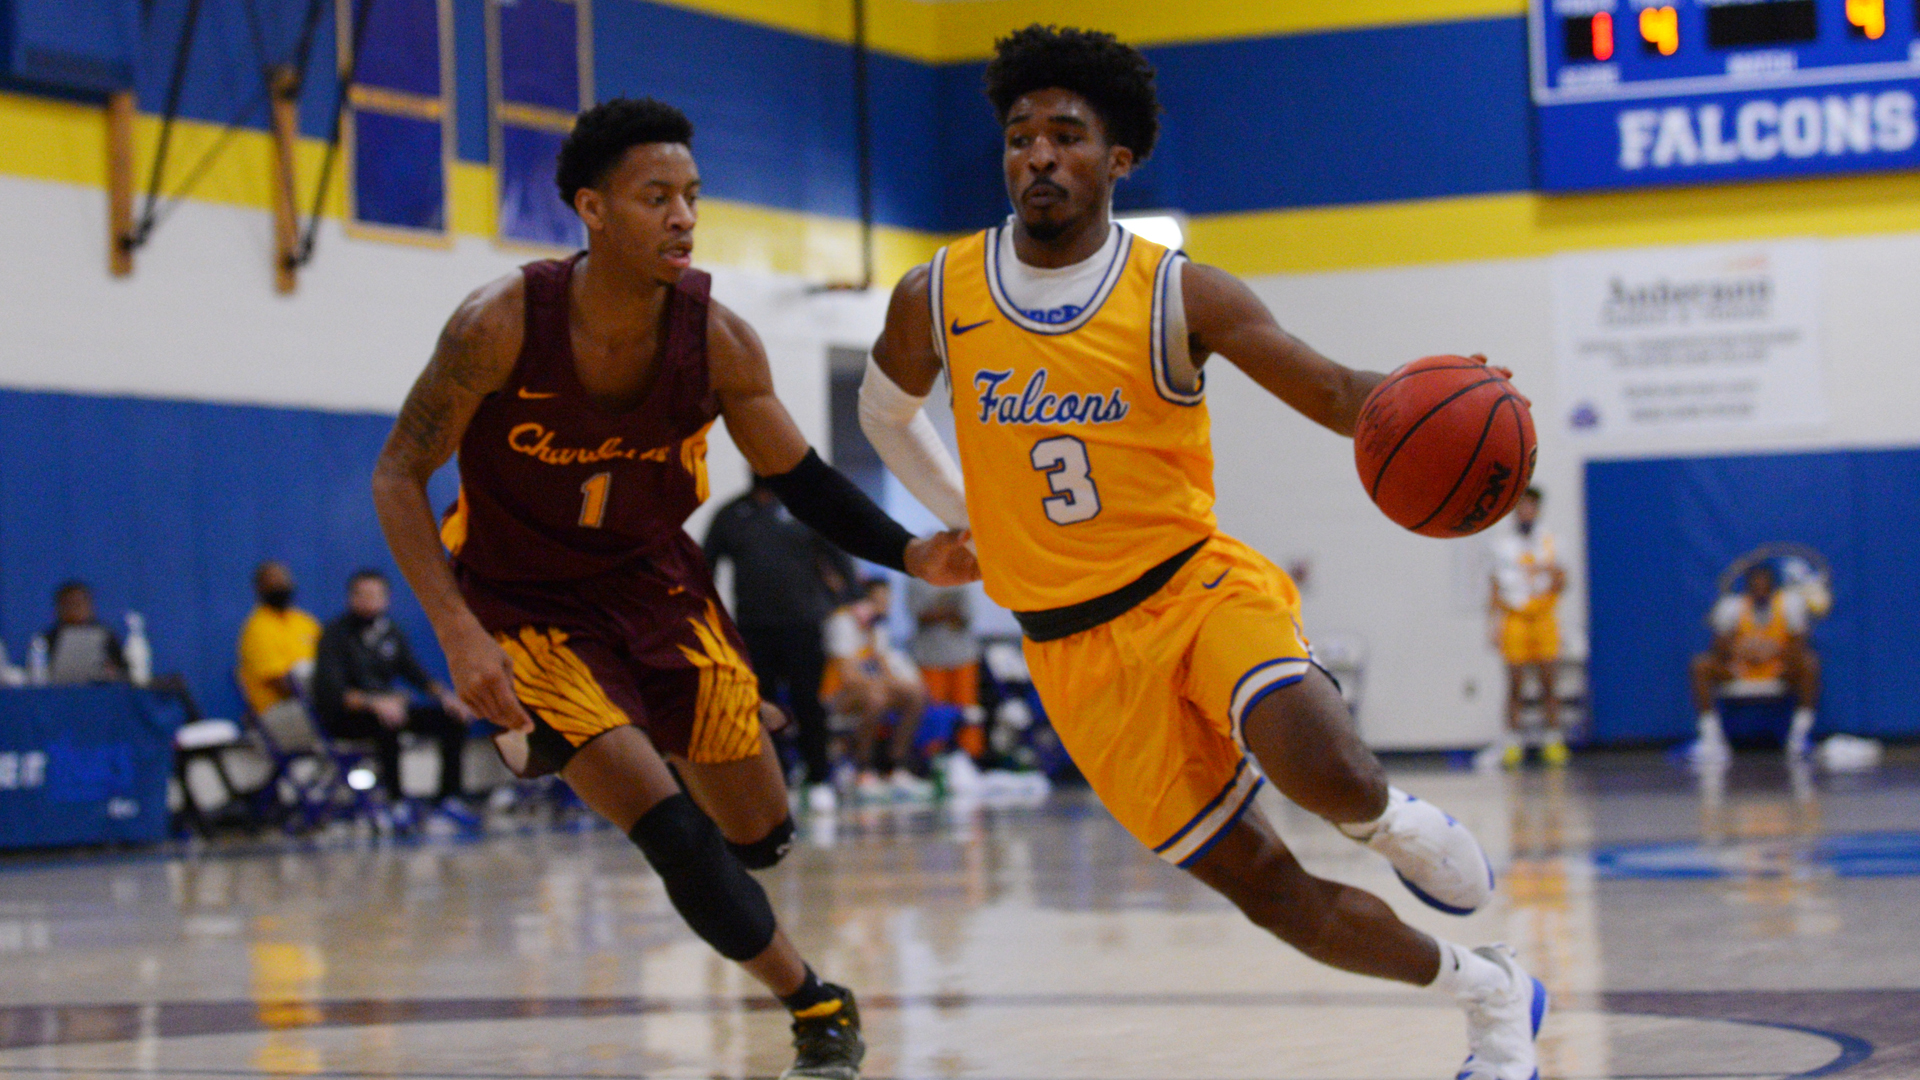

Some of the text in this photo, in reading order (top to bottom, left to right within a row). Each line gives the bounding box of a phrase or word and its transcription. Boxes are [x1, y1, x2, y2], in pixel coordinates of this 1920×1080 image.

[1591, 11, 1614, 60] 1
[1639, 6, 1678, 56] 4
[1845, 0, 1886, 40] 4
[1618, 90, 1918, 171] FALCONS
[974, 368, 1129, 425] Falcons
[578, 472, 612, 528] 1
[1030, 434, 1101, 526] 3
